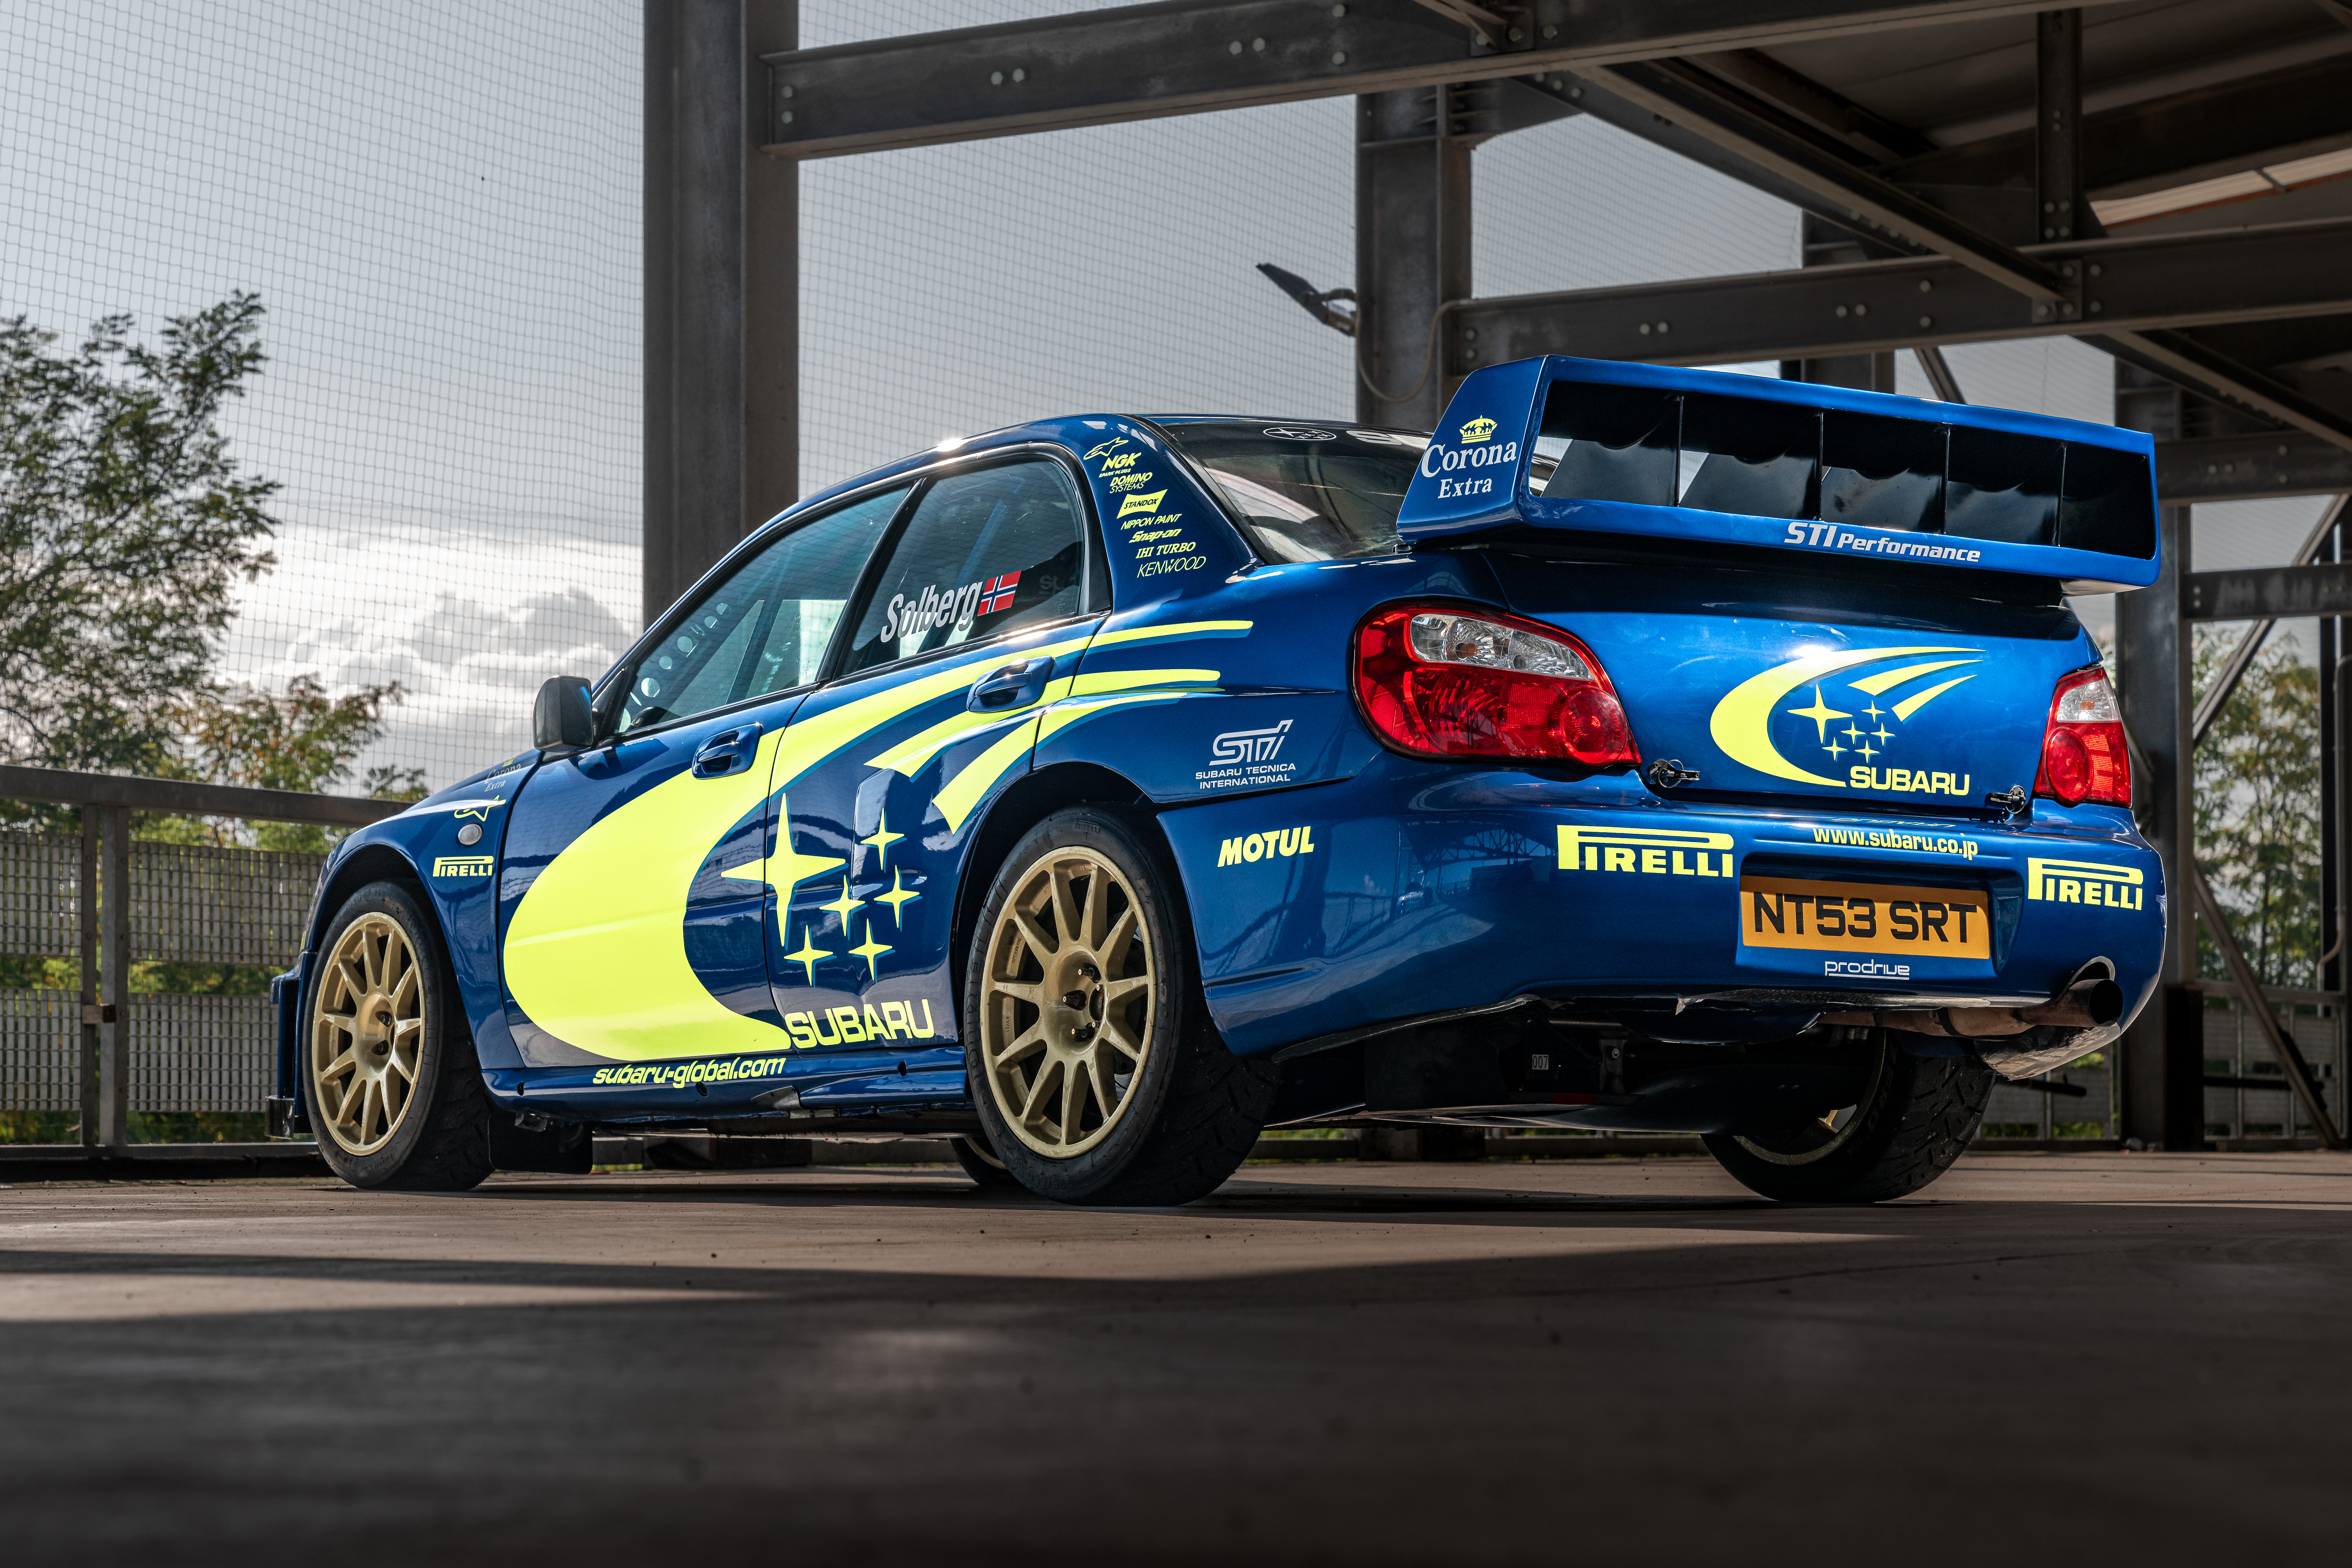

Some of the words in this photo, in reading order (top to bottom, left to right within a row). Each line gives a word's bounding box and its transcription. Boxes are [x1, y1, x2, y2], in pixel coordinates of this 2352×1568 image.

[1102, 452, 1142, 471] NGK
[1421, 441, 1517, 478] Corona
[1110, 472, 1152, 486] DOMINO
[1110, 481, 1145, 494] SYSTEMS
[1438, 478, 1492, 499] Extra
[1124, 498, 1159, 509] STANDOX
[1120, 516, 1154, 530] NIPPON
[1154, 514, 1182, 524] PAINT
[1129, 528, 1182, 543] Snap-on
[1784, 522, 1838, 547] STI
[1840, 533, 1980, 563] Performance
[1135, 546, 1152, 559] IHI
[1156, 542, 1196, 555] TURBO
[1137, 556, 1206, 578] KENWOOD
[881, 581, 983, 642] Solberg
[484, 763, 521, 784] Corona
[1195, 768, 1242, 780] SUBARU
[1245, 763, 1296, 774] TECNICA
[1200, 774, 1290, 789] INTERNATIONAL
[1850, 766, 1970, 796] SUBARU
[484, 780, 506, 792] Extra
[1217, 826, 1314, 867] MOTUL
[1557, 825, 1734, 878] PIRELLI
[1813, 828, 1978, 860] www.subaru.co.jp
[432, 856, 494, 877] PIRELLI
[2027, 857, 2143, 910] PIRELLI
[1753, 892, 1877, 938] NT53
[1889, 900, 1977, 944] SRT
[1011, 936, 1022, 964] SPEEDLINE
[1825, 959, 1909, 976] prodrive
[784, 998, 935, 1049] SUBARU
[593, 1056, 786, 1089] subaru-global.com
[1533, 1055, 1548, 1069] 007
